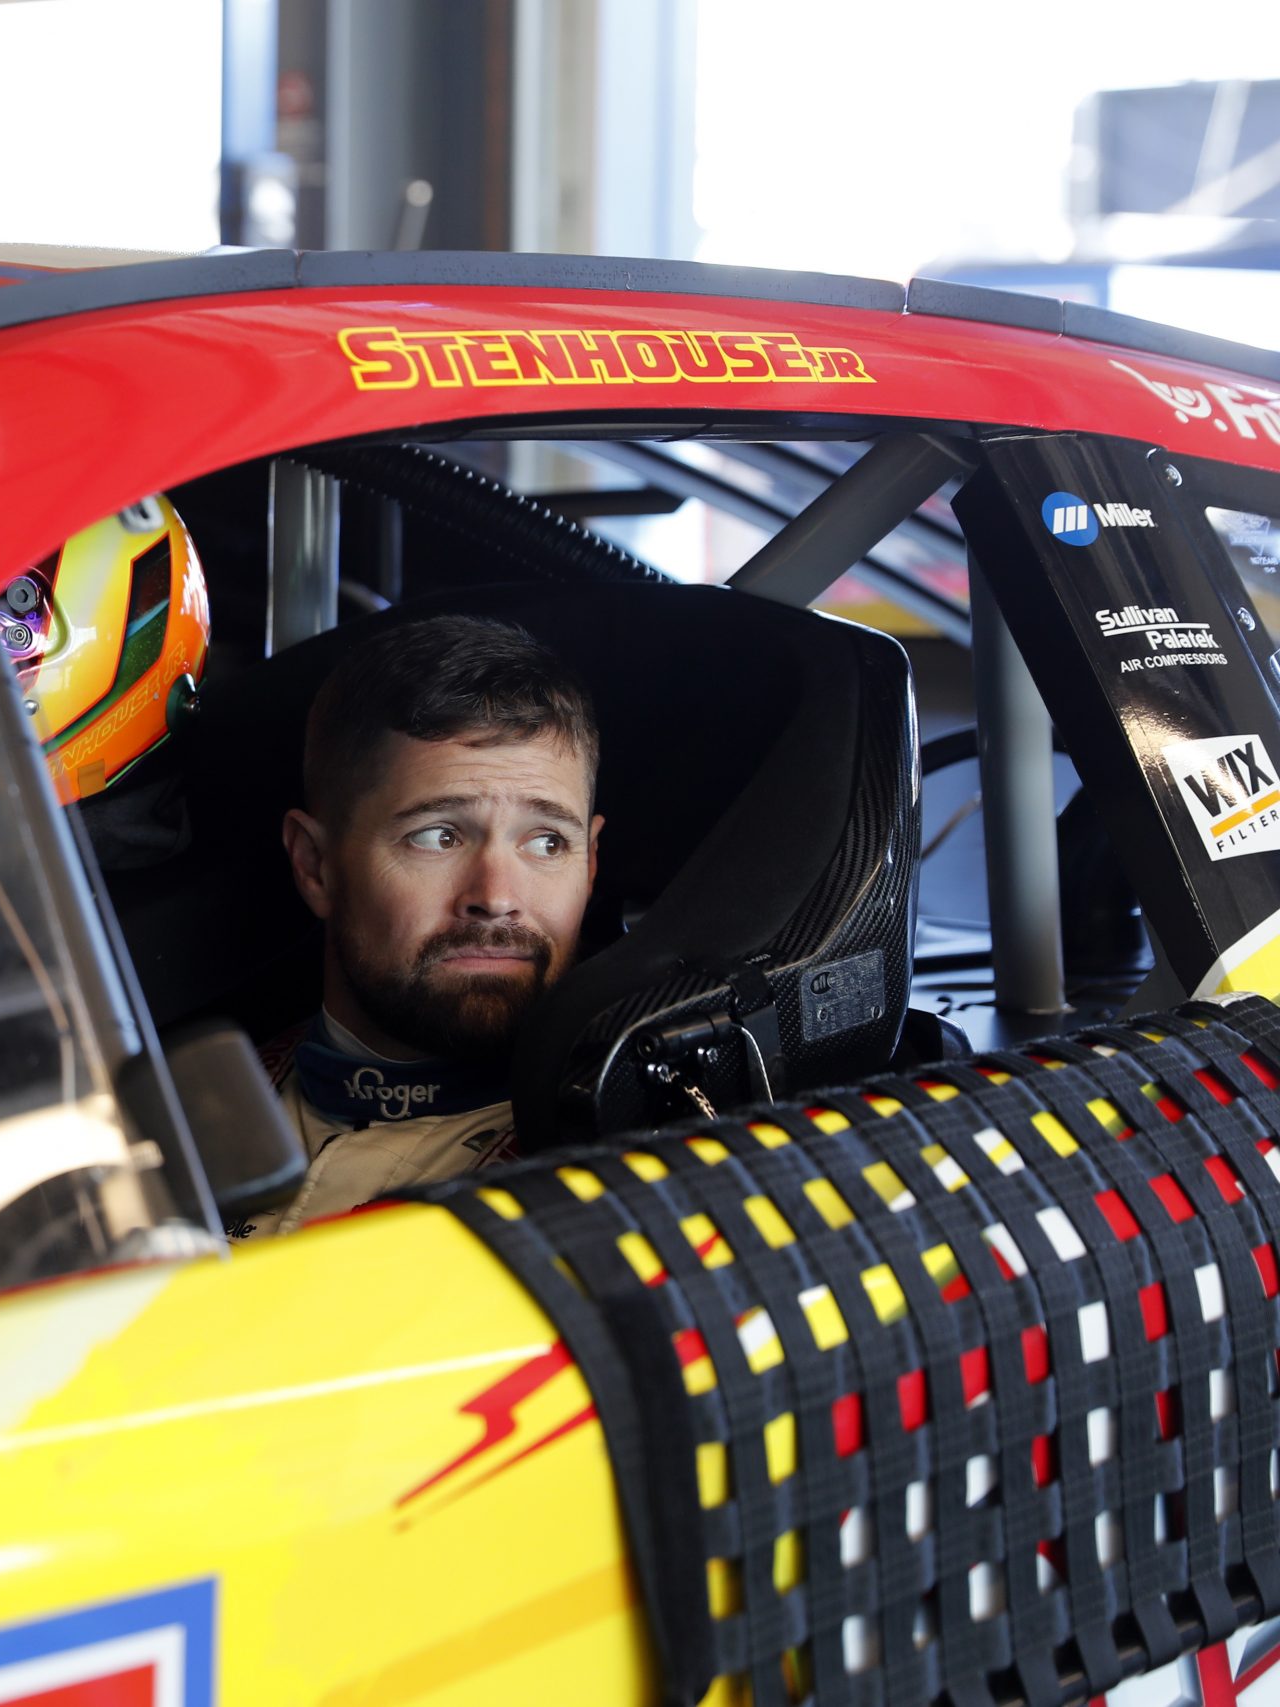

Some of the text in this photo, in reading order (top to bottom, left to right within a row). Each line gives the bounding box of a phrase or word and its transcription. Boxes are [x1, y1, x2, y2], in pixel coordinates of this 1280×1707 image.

[337, 327, 878, 391] STENHOUSE JR
[1093, 503, 1155, 528] Miller
[1095, 606, 1179, 631] Sullivan
[1147, 629, 1219, 650] Palatek
[1121, 653, 1228, 673] AIR COMPRESSORS
[1183, 742, 1275, 818] WIX
[343, 1067, 441, 1119] Kroger
